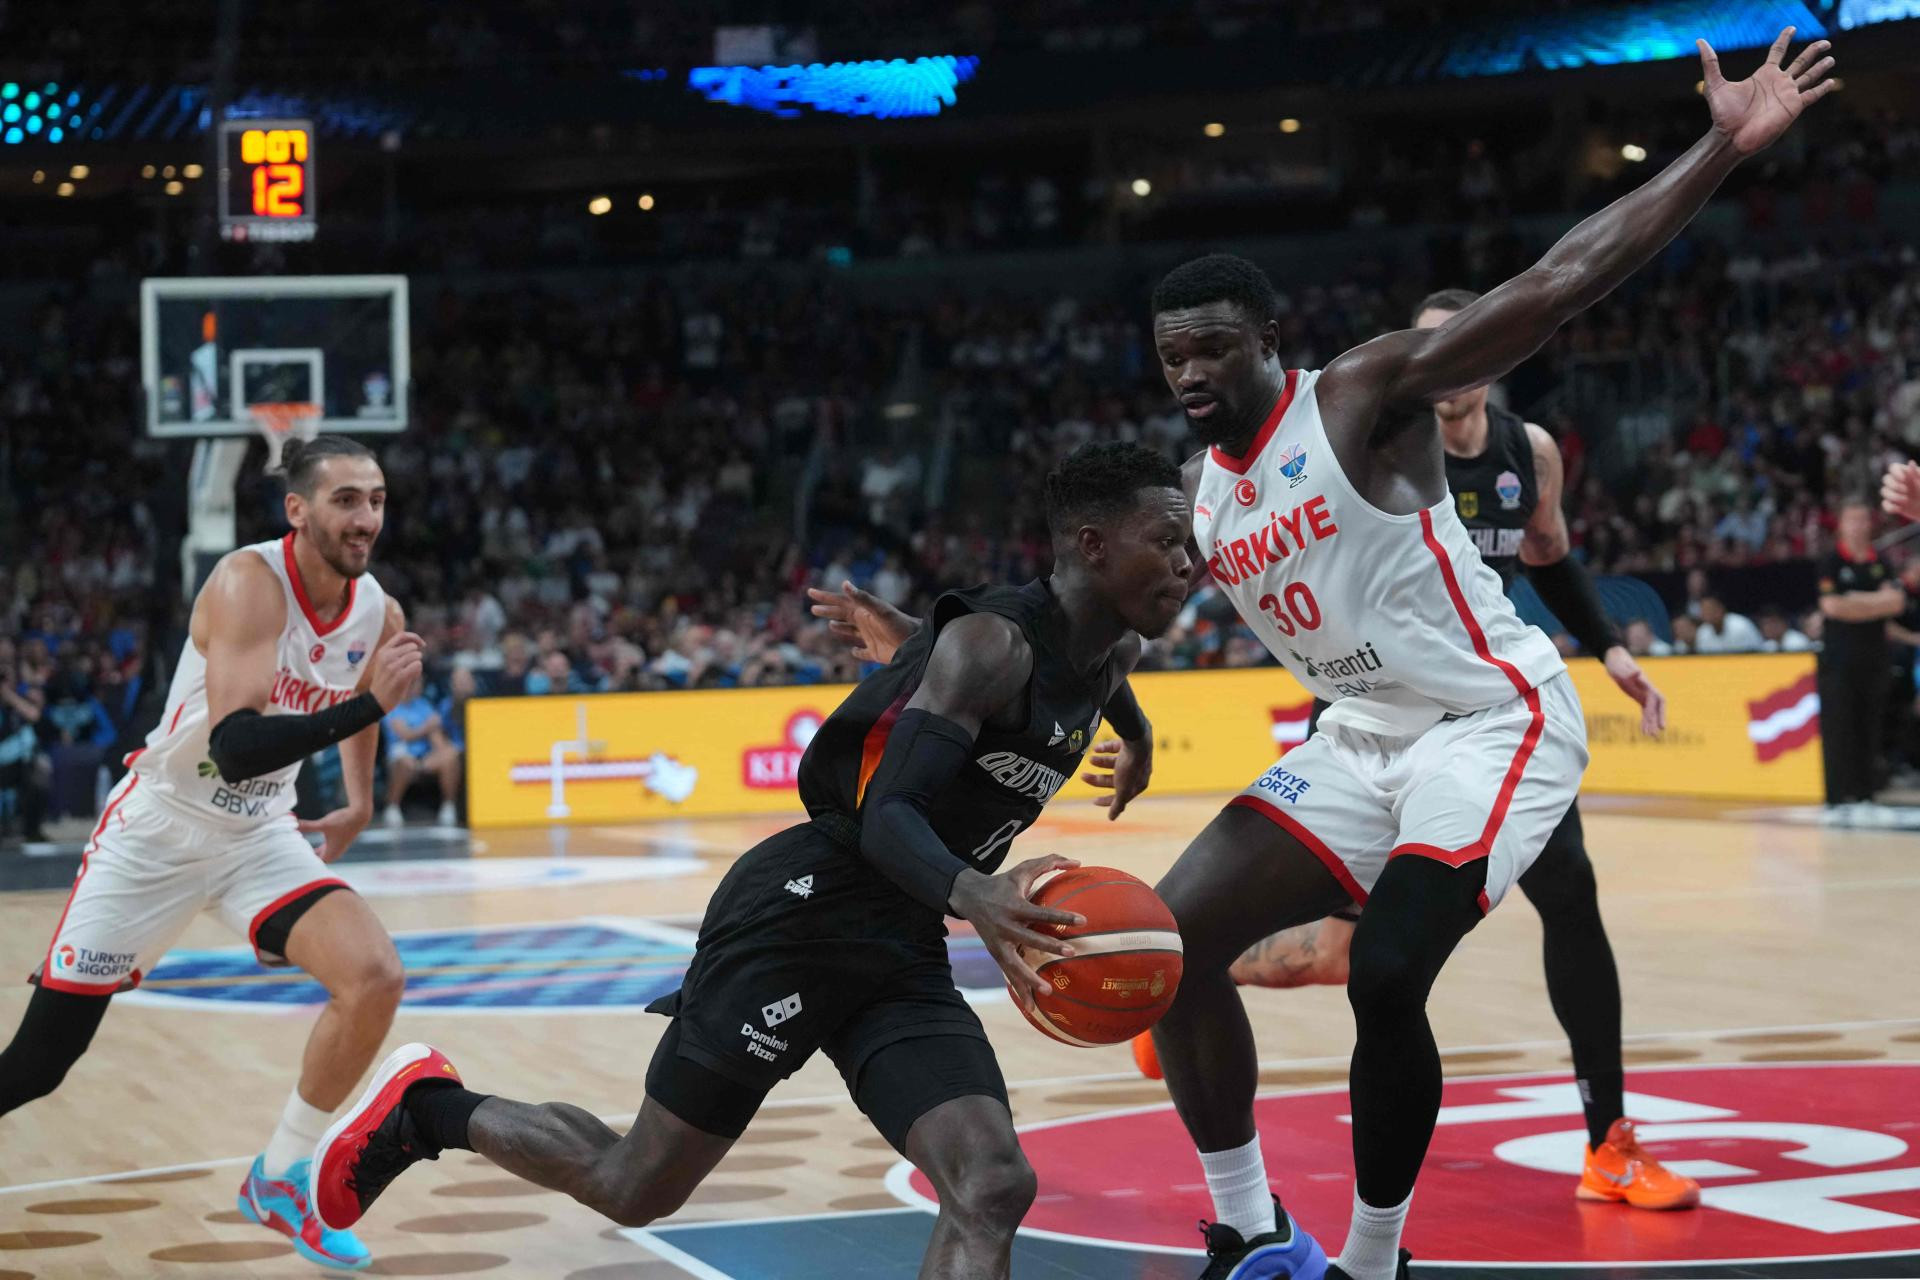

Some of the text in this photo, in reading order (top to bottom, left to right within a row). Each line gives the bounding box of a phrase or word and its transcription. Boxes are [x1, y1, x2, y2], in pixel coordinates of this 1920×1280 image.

[251, 165, 304, 217] 12
[1258, 581, 1322, 637] 30
[740, 1022, 789, 1052] Domino's
[746, 1040, 778, 1062] Pizza
